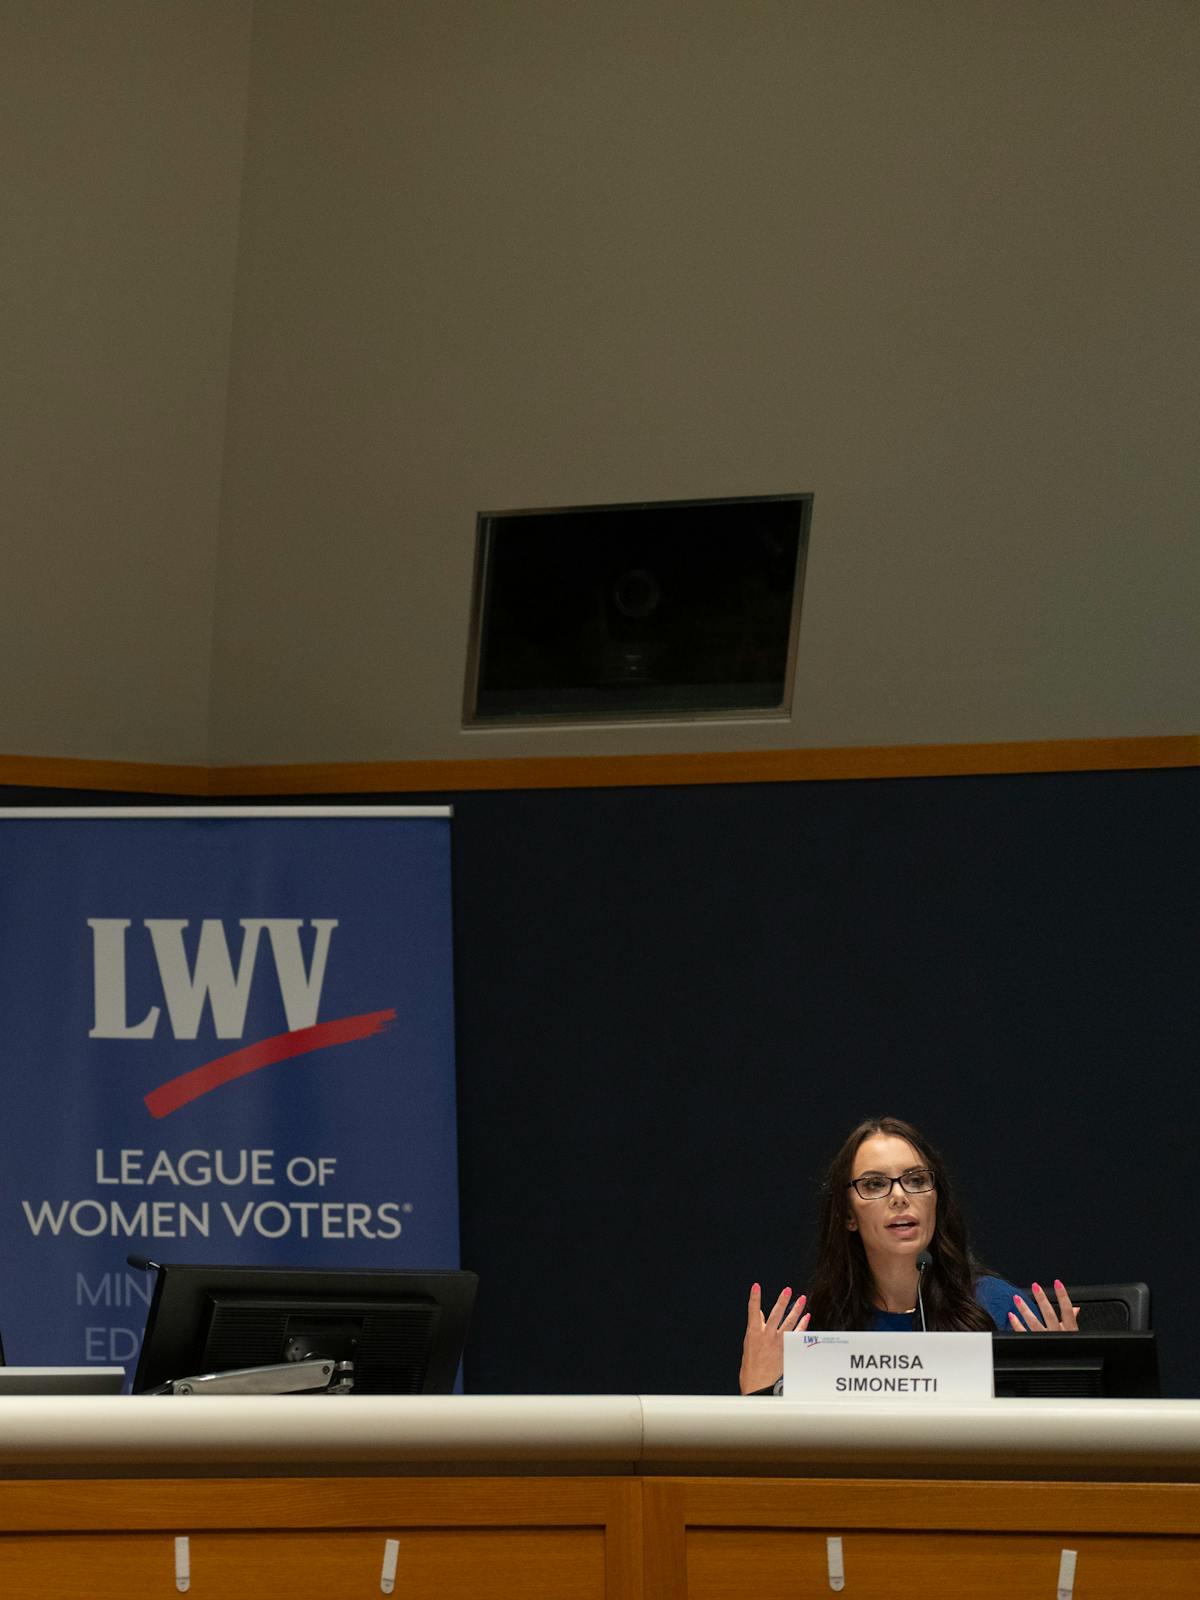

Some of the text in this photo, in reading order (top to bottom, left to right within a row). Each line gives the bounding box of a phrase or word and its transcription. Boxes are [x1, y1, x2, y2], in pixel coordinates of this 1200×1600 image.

[87, 918, 339, 1040] LWV
[96, 1148, 337, 1187] LEAGUE OF
[21, 1200, 210, 1238] WOMEN
[76, 1271, 154, 1307] MIN
[85, 1326, 146, 1361] ED
[850, 1354, 924, 1370] MARISA
[835, 1377, 937, 1393] SIMONETTI
